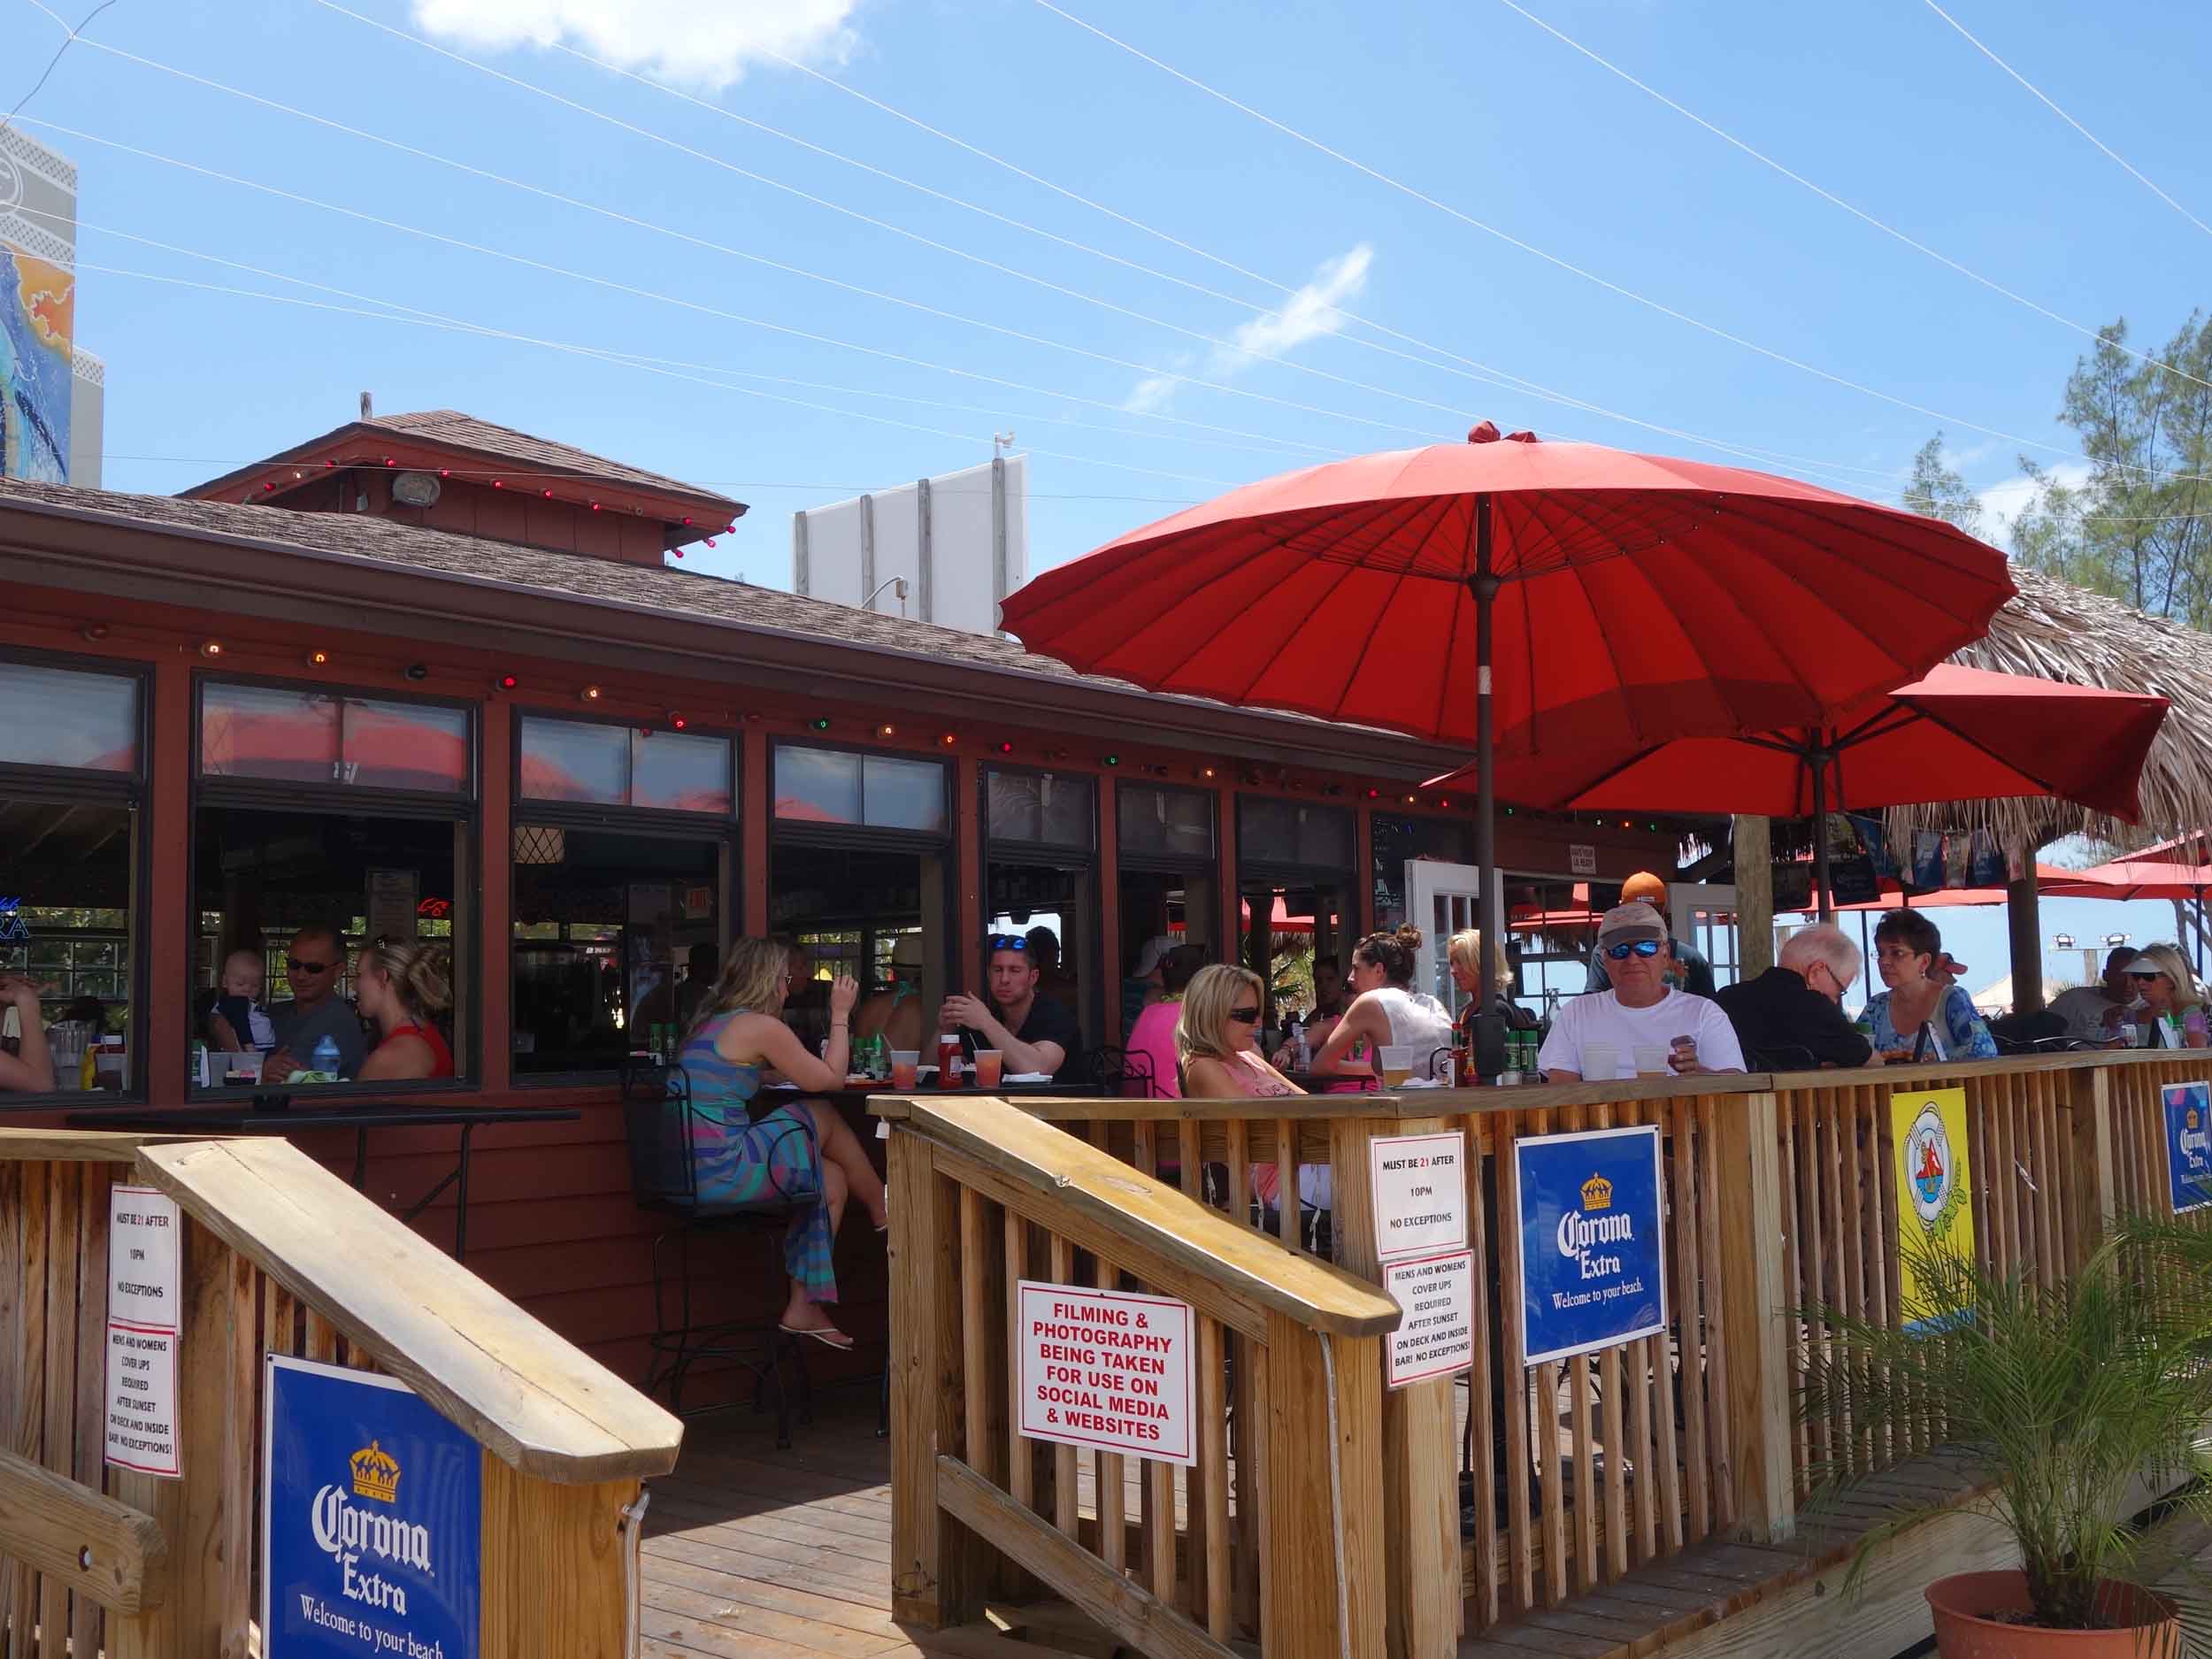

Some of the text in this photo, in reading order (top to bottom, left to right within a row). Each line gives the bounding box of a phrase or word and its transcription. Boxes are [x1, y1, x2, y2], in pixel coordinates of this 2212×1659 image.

[1383, 1155, 1455, 1171] MUST BE 21 AFTER
[1410, 1187, 1432, 1197] 10PM
[117, 1213, 169, 1228] MUST BE 21 AFTER
[1390, 1212, 1452, 1229] NO EXCEPTIONS
[1557, 1210, 1632, 1261] Corona
[129, 1248, 145, 1261] 10PM
[1579, 1249, 1621, 1280] Extra
[1394, 1260, 1466, 1281] MENS AND WOMENS
[117, 1281, 164, 1298] NO EXCEPTIONS
[1412, 1279, 1452, 1295] COVER UPS
[1552, 1276, 1644, 1310] Welcome to your beach.
[1415, 1297, 1451, 1311] REQUIRED
[1054, 1302, 1148, 1328] FILMING &
[1408, 1312, 1458, 1331] AFTER SUNSET
[126, 1337, 135, 1348] AND
[135, 1339, 167, 1352] WOMENS
[1033, 1321, 1172, 1354] PHOTOGRAPHY
[1396, 1325, 1469, 1350] ON DECK AND INSIDE
[121, 1356, 150, 1371] COVER UPS
[1041, 1343, 1164, 1375] BEING TAKEN
[1394, 1340, 1471, 1367] BAR! NO EXCEPTIONS!
[121, 1376, 149, 1391] REQUIRED
[1047, 1365, 1158, 1396] FOR USE ON
[117, 1395, 156, 1413] AFTER SUNSET
[1037, 1385, 1170, 1420] SOCIAL MEDIA
[109, 1413, 169, 1435] ON DECK AND INSIDE
[1047, 1408, 1160, 1440] & WEBSITES
[120, 1435, 128, 1448] NO
[128, 1438, 173, 1455] EXCEPTIONS!
[311, 1484, 431, 1572] Corona
[342, 1551, 407, 1616] Extra
[300, 1594, 443, 1659] Welcome to your beach
